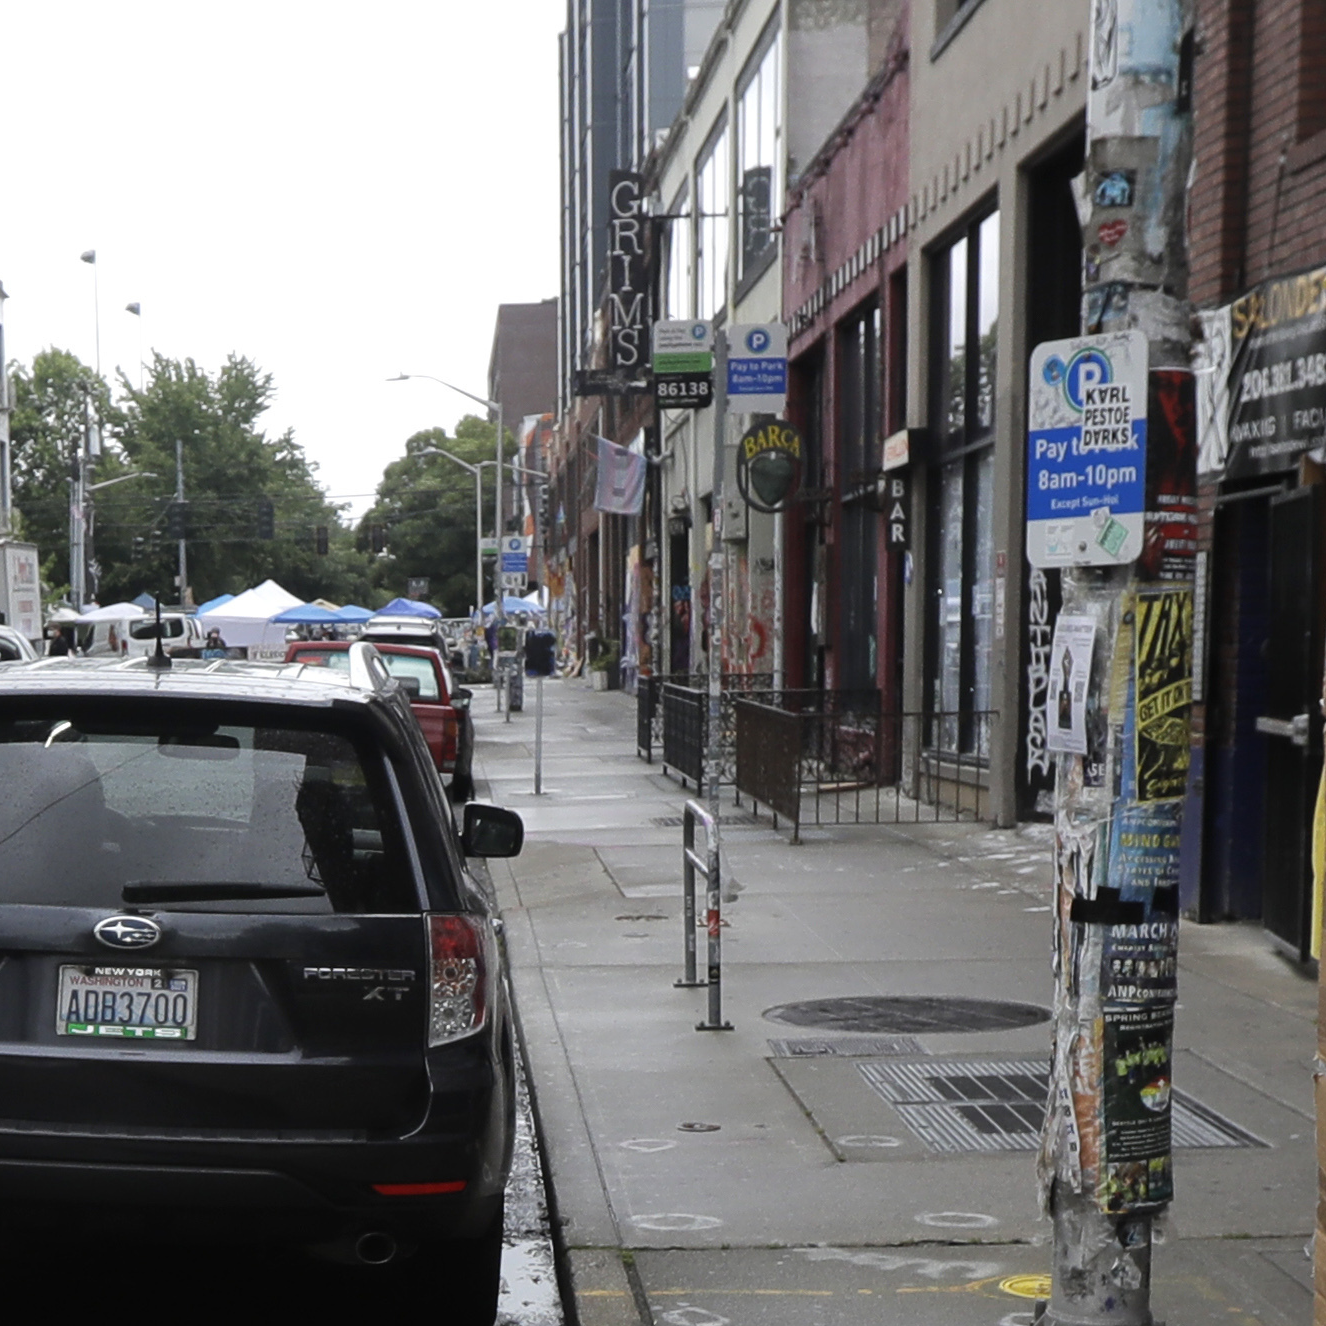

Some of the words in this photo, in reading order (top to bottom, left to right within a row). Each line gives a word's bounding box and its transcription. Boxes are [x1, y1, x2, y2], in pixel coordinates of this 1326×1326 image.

[610, 180, 644, 366] GRIMS
[731, 361, 748, 373] Pay
[750, 361, 760, 371] to
[762, 361, 784, 371] Park
[657, 381, 709, 397] 86138
[743, 424, 802, 460] BARCA
[1035, 438, 1068, 462] Pay
[1038, 463, 1137, 490] 8am-10pm
[890, 479, 906, 543] BAR
[1050, 496, 1081, 510] Except
[1110, 922, 1168, 940] MARCH
[95, 966, 125, 976] NEW
[126, 968, 162, 977] YORK
[303, 967, 416, 981] FORESTER
[70, 975, 144, 987] WASHINGTON
[361, 986, 410, 1001] XT
[66, 989, 188, 1026] ADB3700
[71, 1024, 183, 1038] JETS
